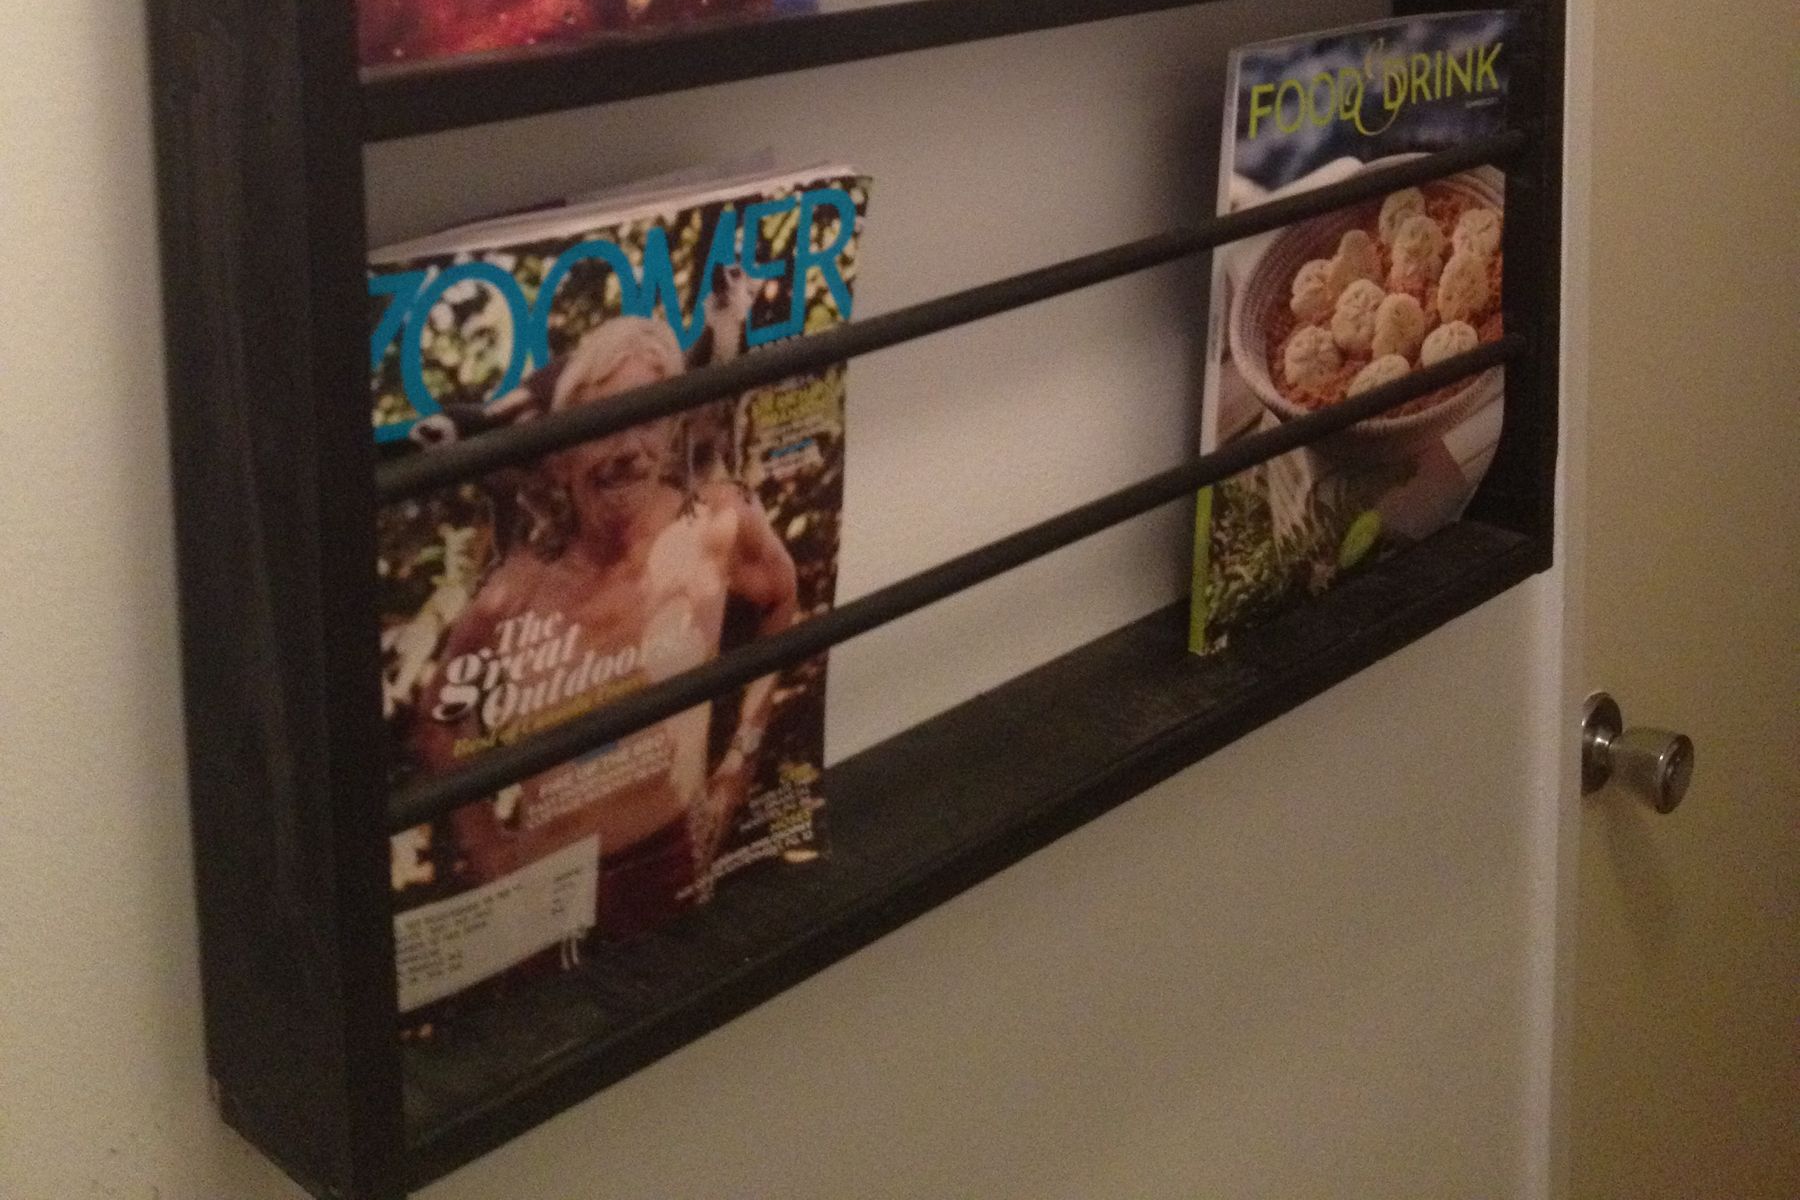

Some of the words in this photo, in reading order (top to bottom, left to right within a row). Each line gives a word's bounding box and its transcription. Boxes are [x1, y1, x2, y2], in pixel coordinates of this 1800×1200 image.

[1250, 66, 1364, 139] FOOD
[1383, 42, 1503, 111] DRINK
[495, 611, 564, 654] The
